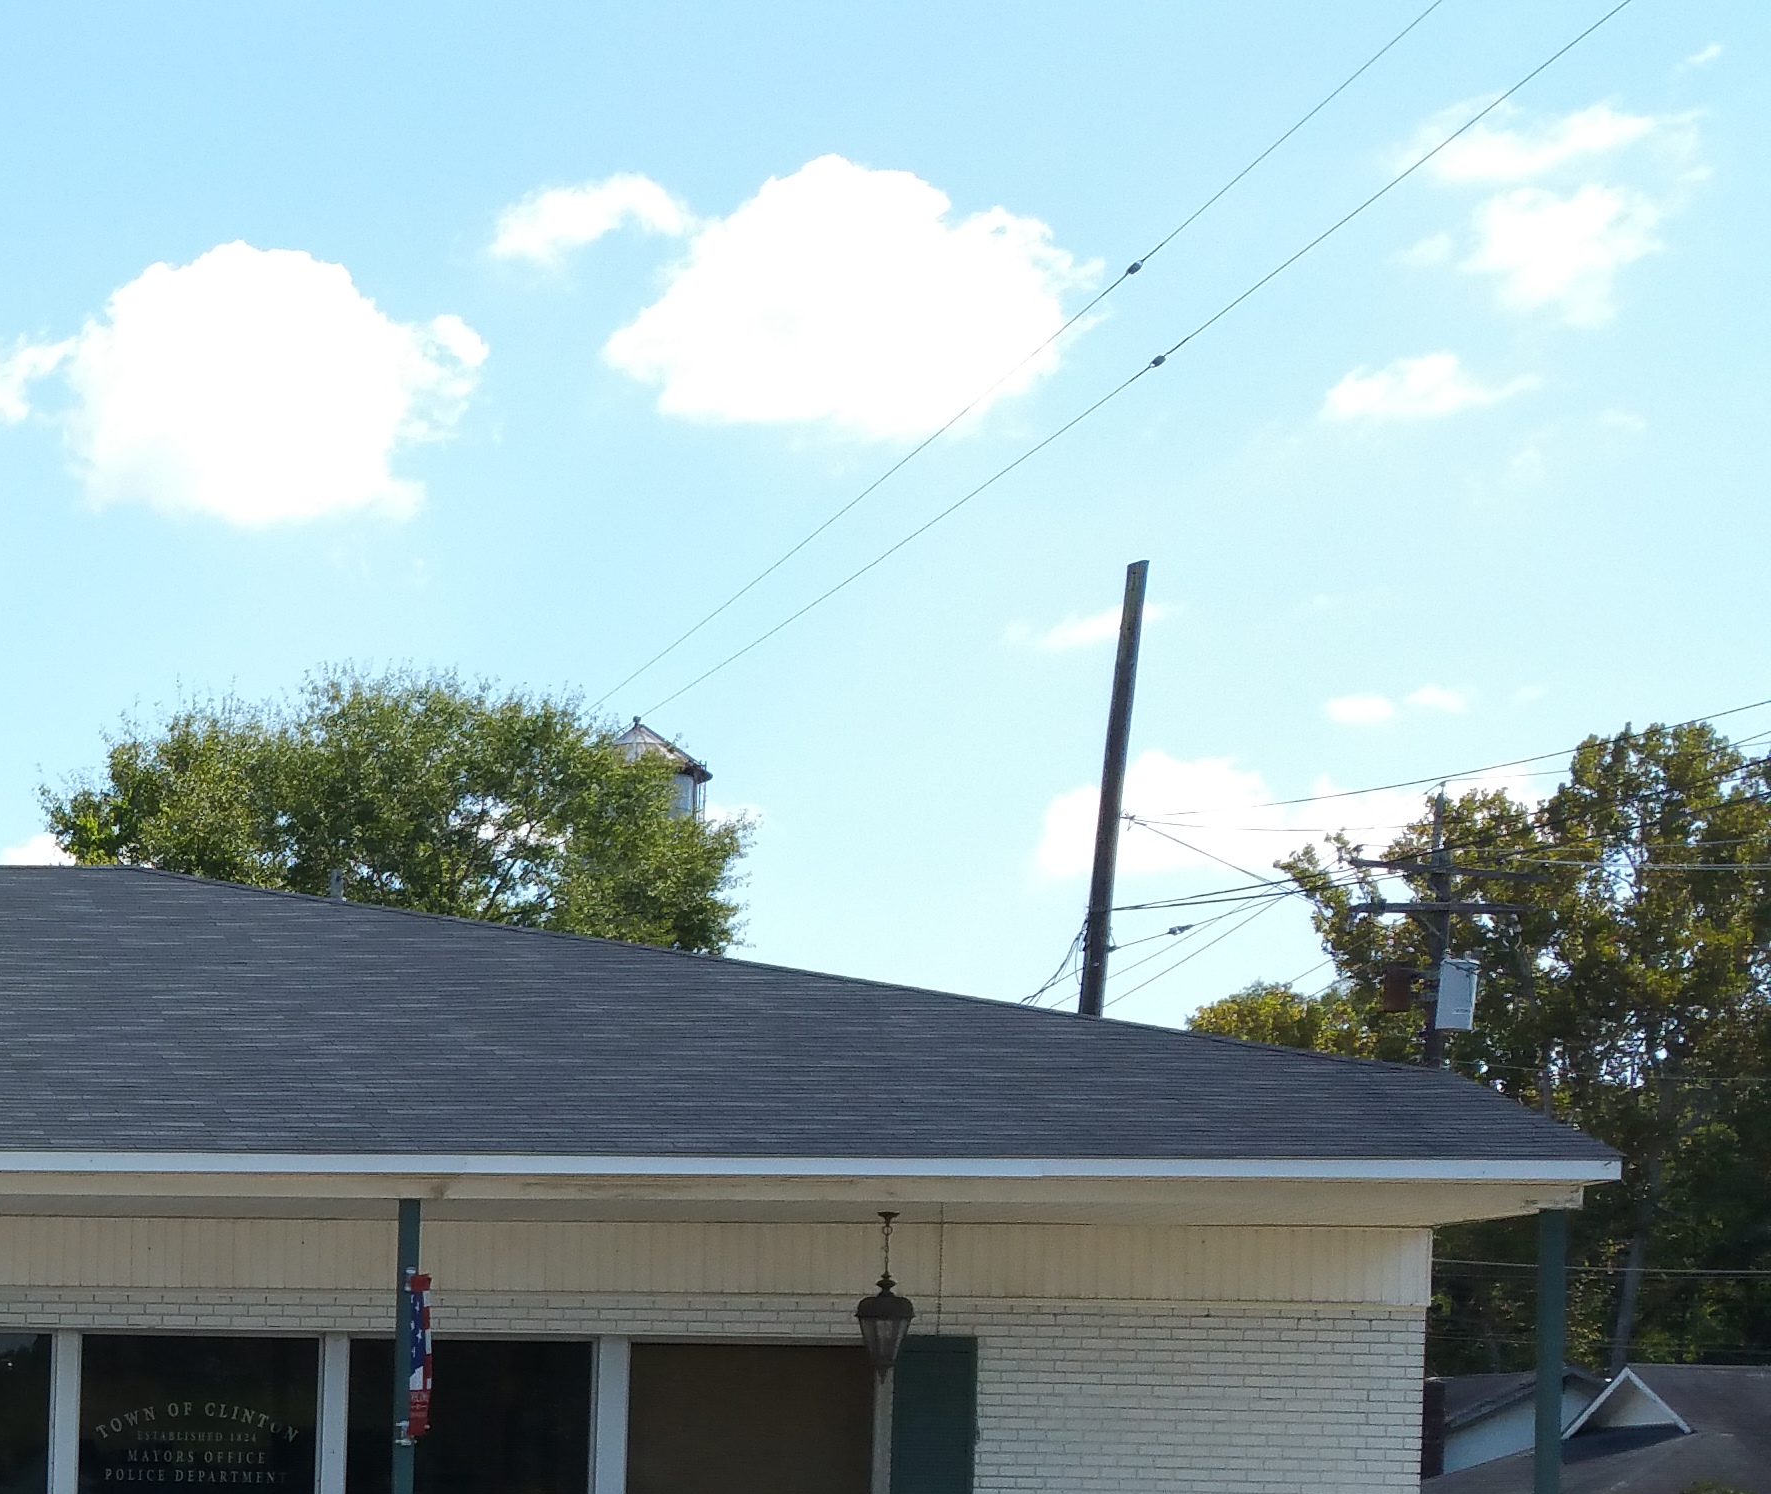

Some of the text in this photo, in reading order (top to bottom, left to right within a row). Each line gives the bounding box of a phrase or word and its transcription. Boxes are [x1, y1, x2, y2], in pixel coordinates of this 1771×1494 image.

[96, 1402, 299, 1442] TOWN OF CLINTON
[138, 1430, 223, 1442] ESTABLISHED
[128, 1450, 265, 1464] MAYORS OFFICE
[105, 1469, 288, 1484] POLICE DEPARTMENT
